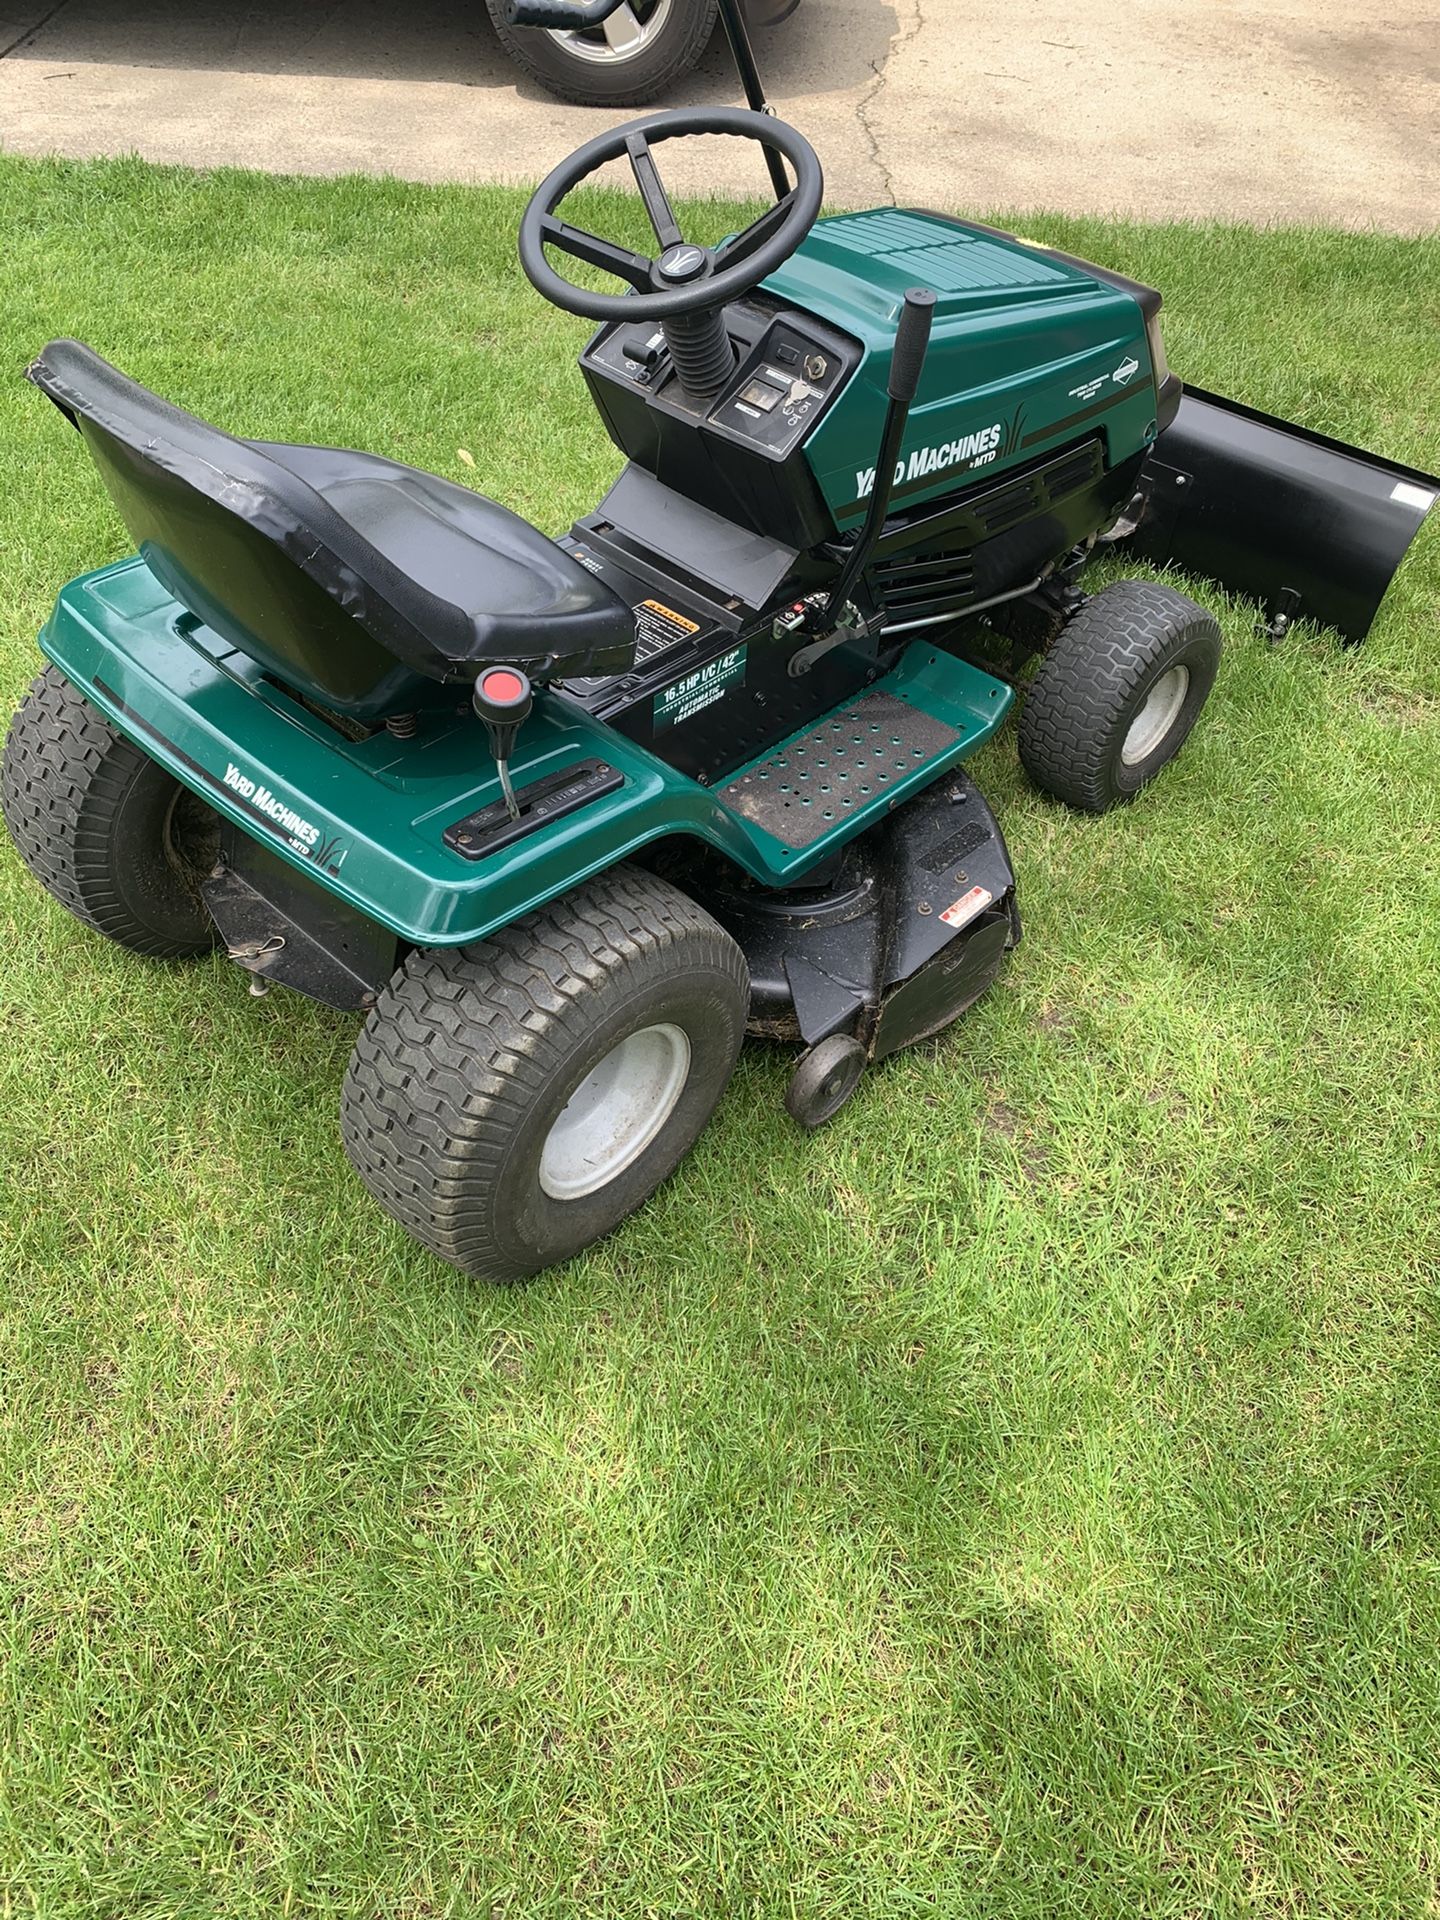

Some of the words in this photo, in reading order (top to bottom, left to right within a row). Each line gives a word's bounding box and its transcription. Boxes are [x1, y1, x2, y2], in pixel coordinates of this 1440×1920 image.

[856, 461, 905, 499] YAD
[907, 424, 1001, 481] MACHINES
[974, 450, 997, 469] MTD
[664, 681, 686, 703] 16.5
[686, 673, 700, 691] HP
[679, 685, 721, 714] AUTOMATIC
[673, 689, 726, 725] TRANSMISSION
[223, 762, 255, 798] YARD
[251, 786, 320, 845] MACHINES
[291, 838, 310, 855] MTD
